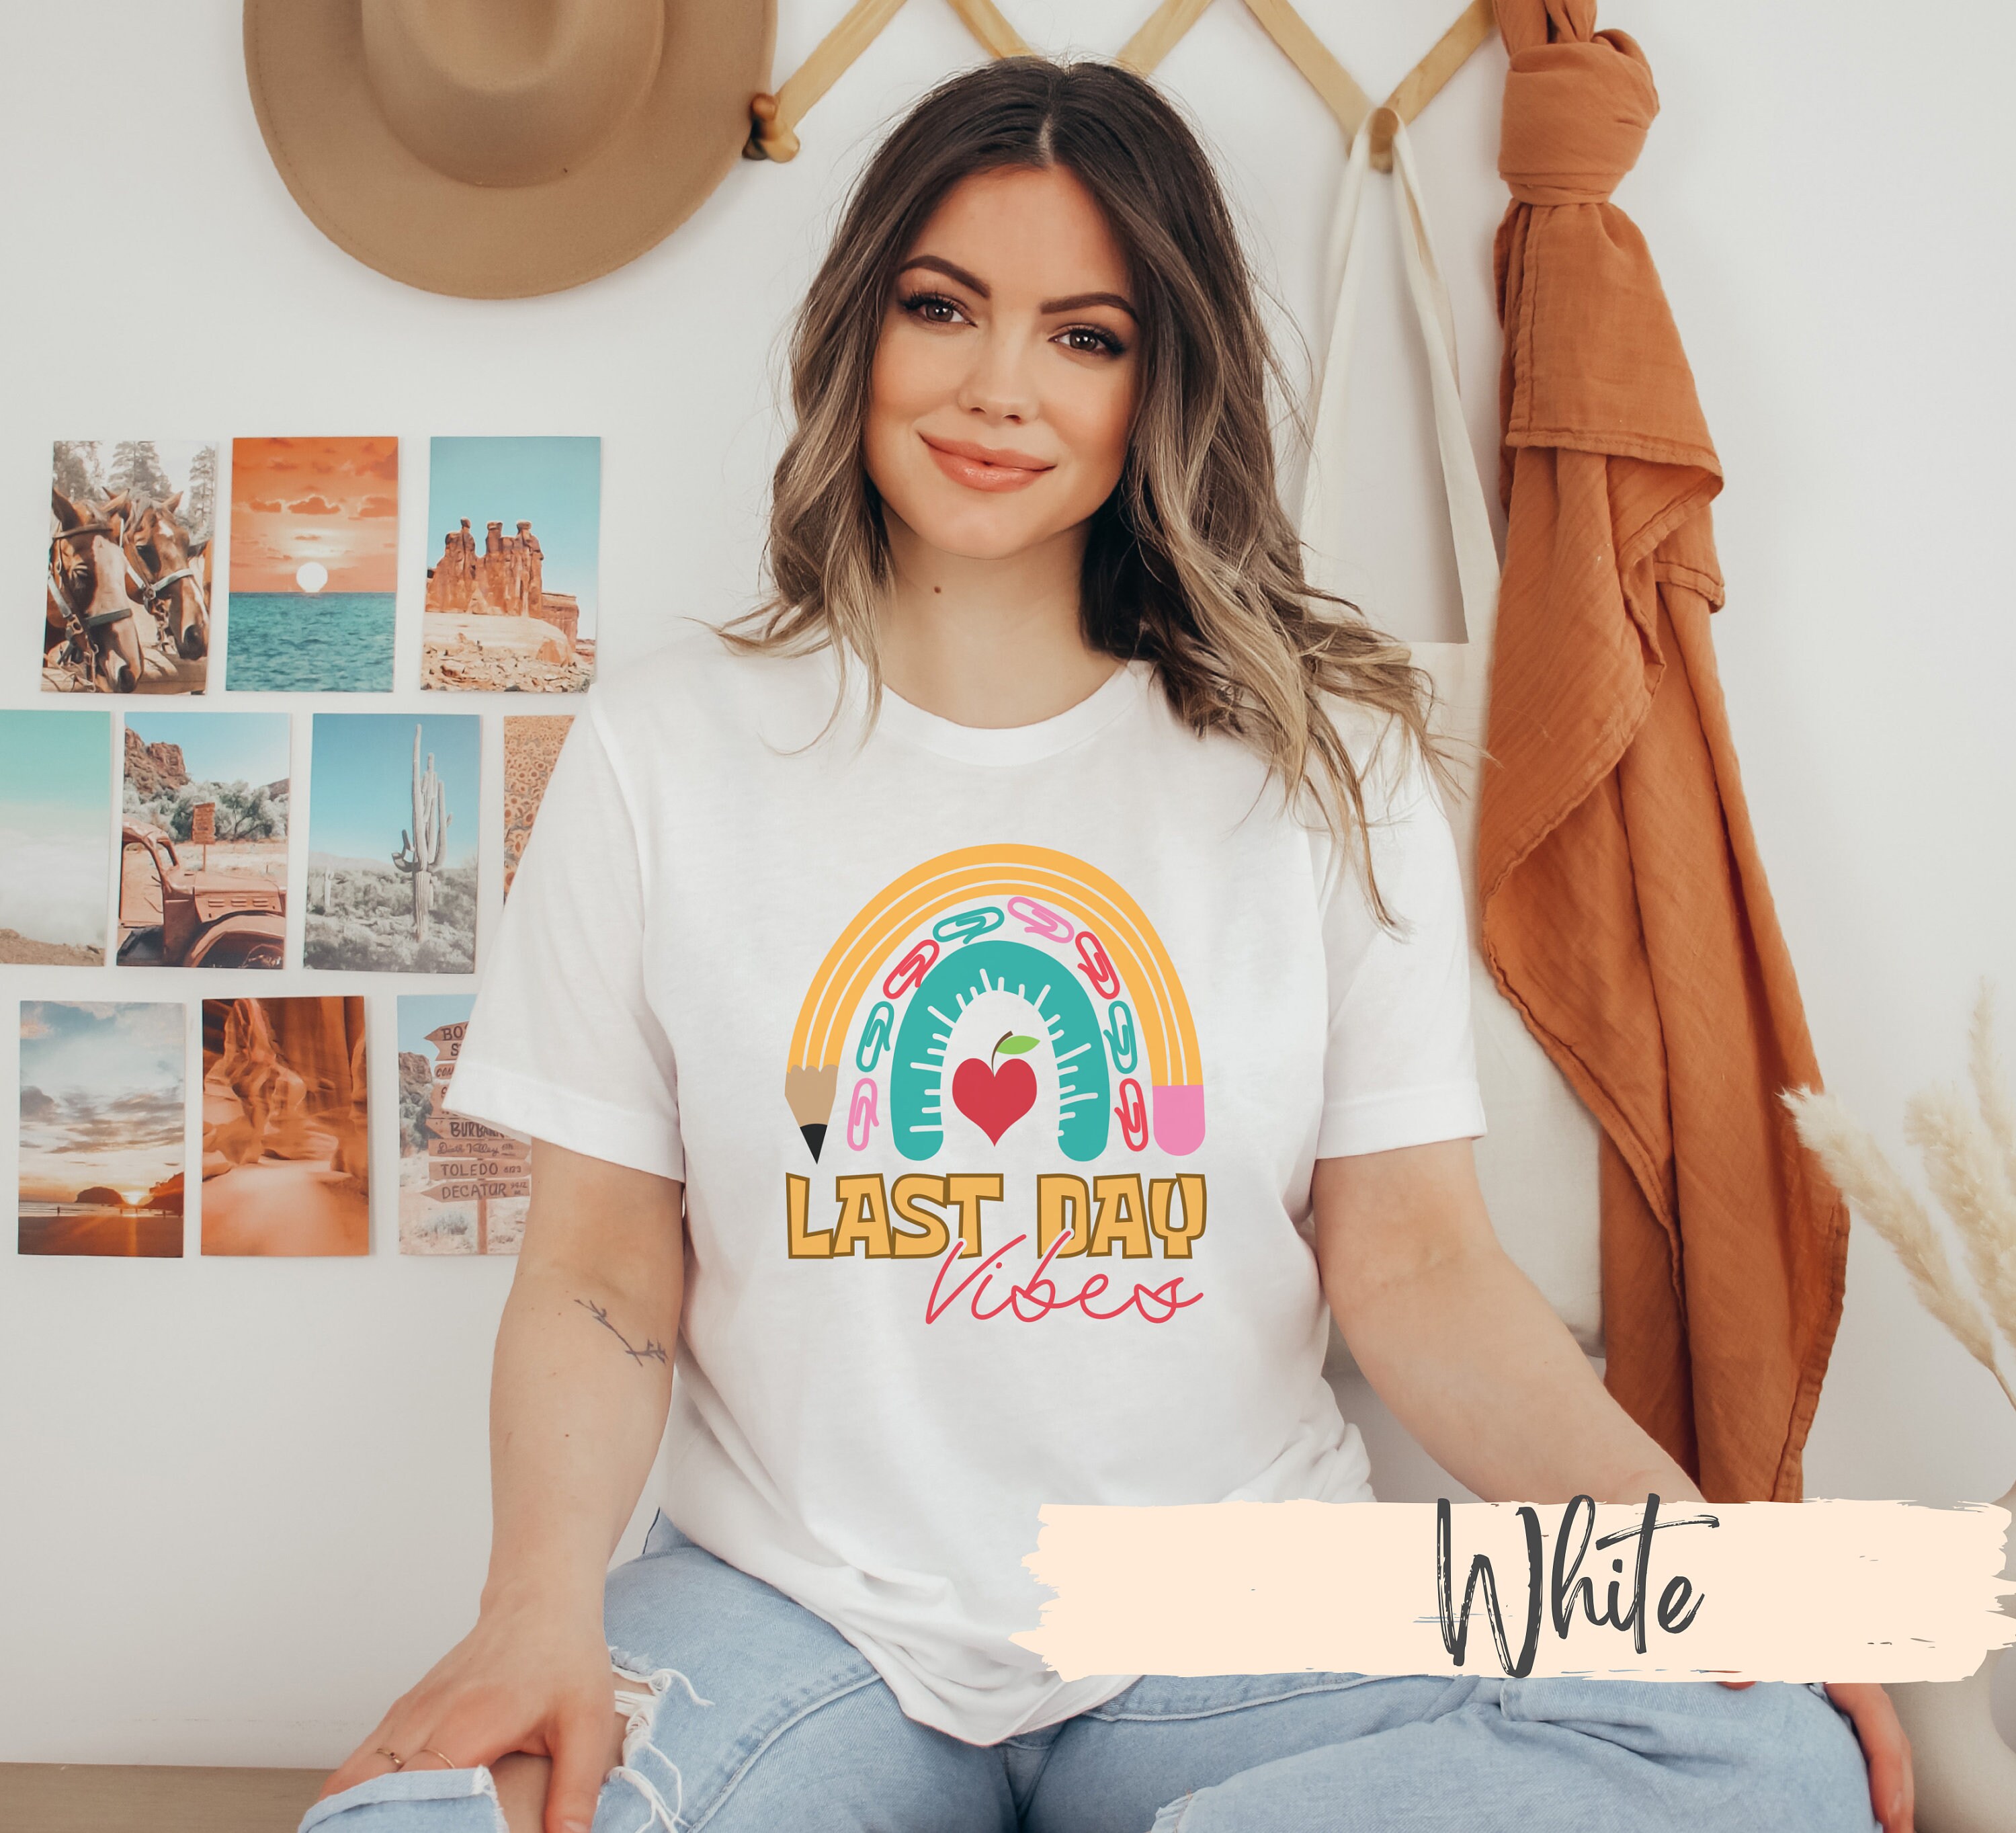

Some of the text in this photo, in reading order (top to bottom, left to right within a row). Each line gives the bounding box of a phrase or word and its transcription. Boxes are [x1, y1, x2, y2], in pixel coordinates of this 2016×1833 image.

[440, 1162, 499, 1176] TOLEDO
[442, 1183, 506, 1200] DECATUR
[786, 1172, 1208, 1260] LAST DAY
[925, 1229, 1204, 1325] Vibes
